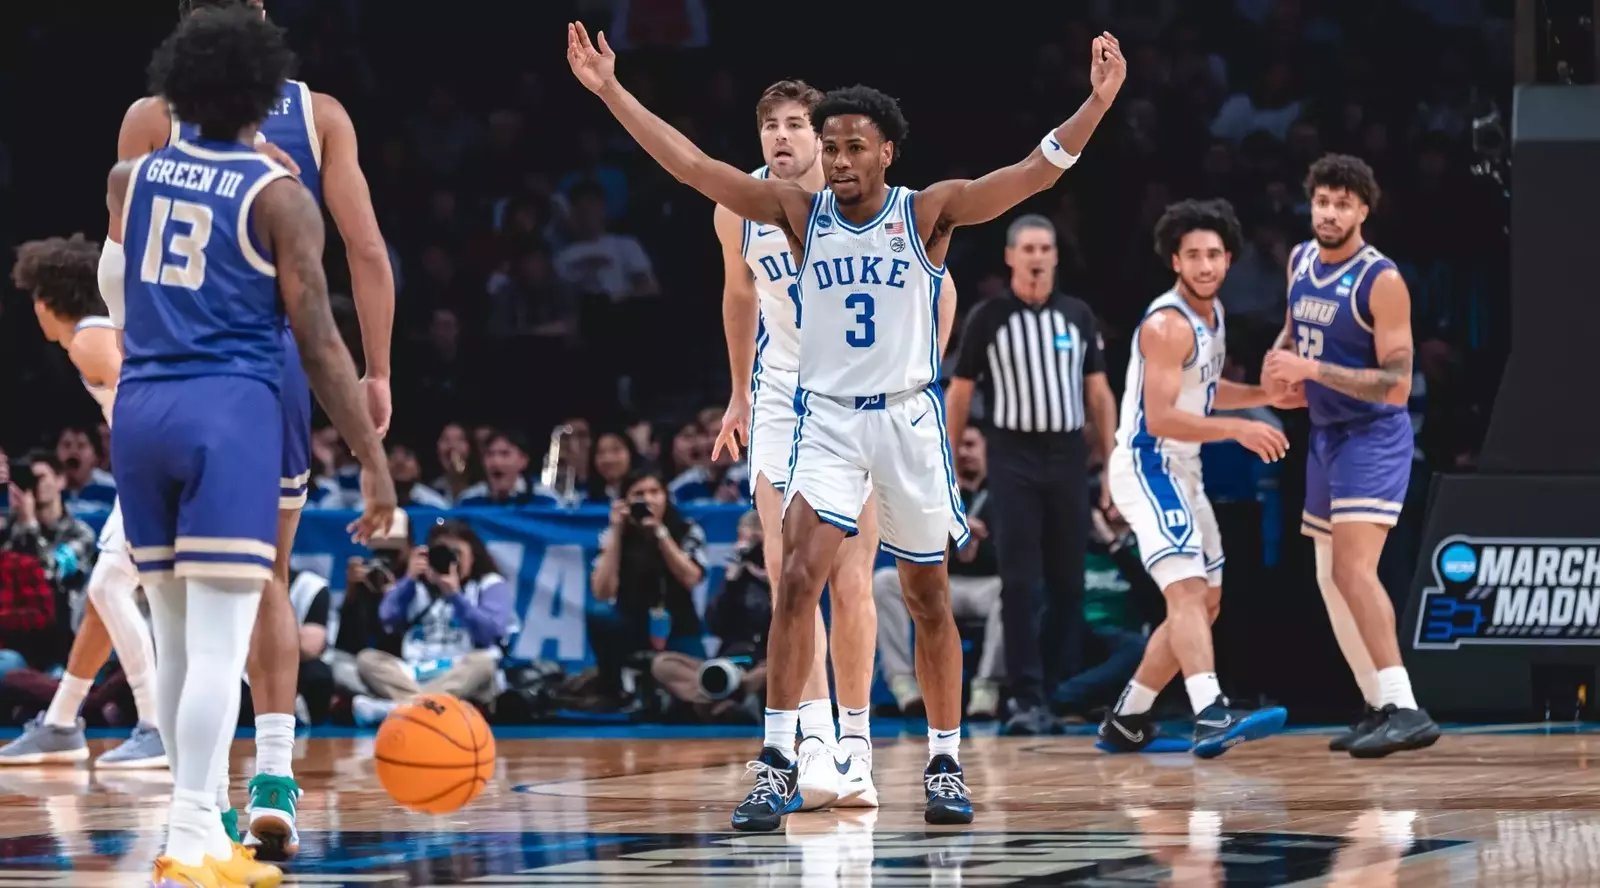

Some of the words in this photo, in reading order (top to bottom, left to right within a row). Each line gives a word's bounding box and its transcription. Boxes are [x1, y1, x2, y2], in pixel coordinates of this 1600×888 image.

[146, 158, 212, 194] GREEN
[215, 172, 244, 198] III
[140, 195, 213, 291] 13
[812, 255, 910, 290] DUKE
[845, 293, 876, 348] 3
[1293, 298, 1338, 325] JMU
[1165, 509, 1187, 528] D
[1477, 546, 1600, 586] MARCH
